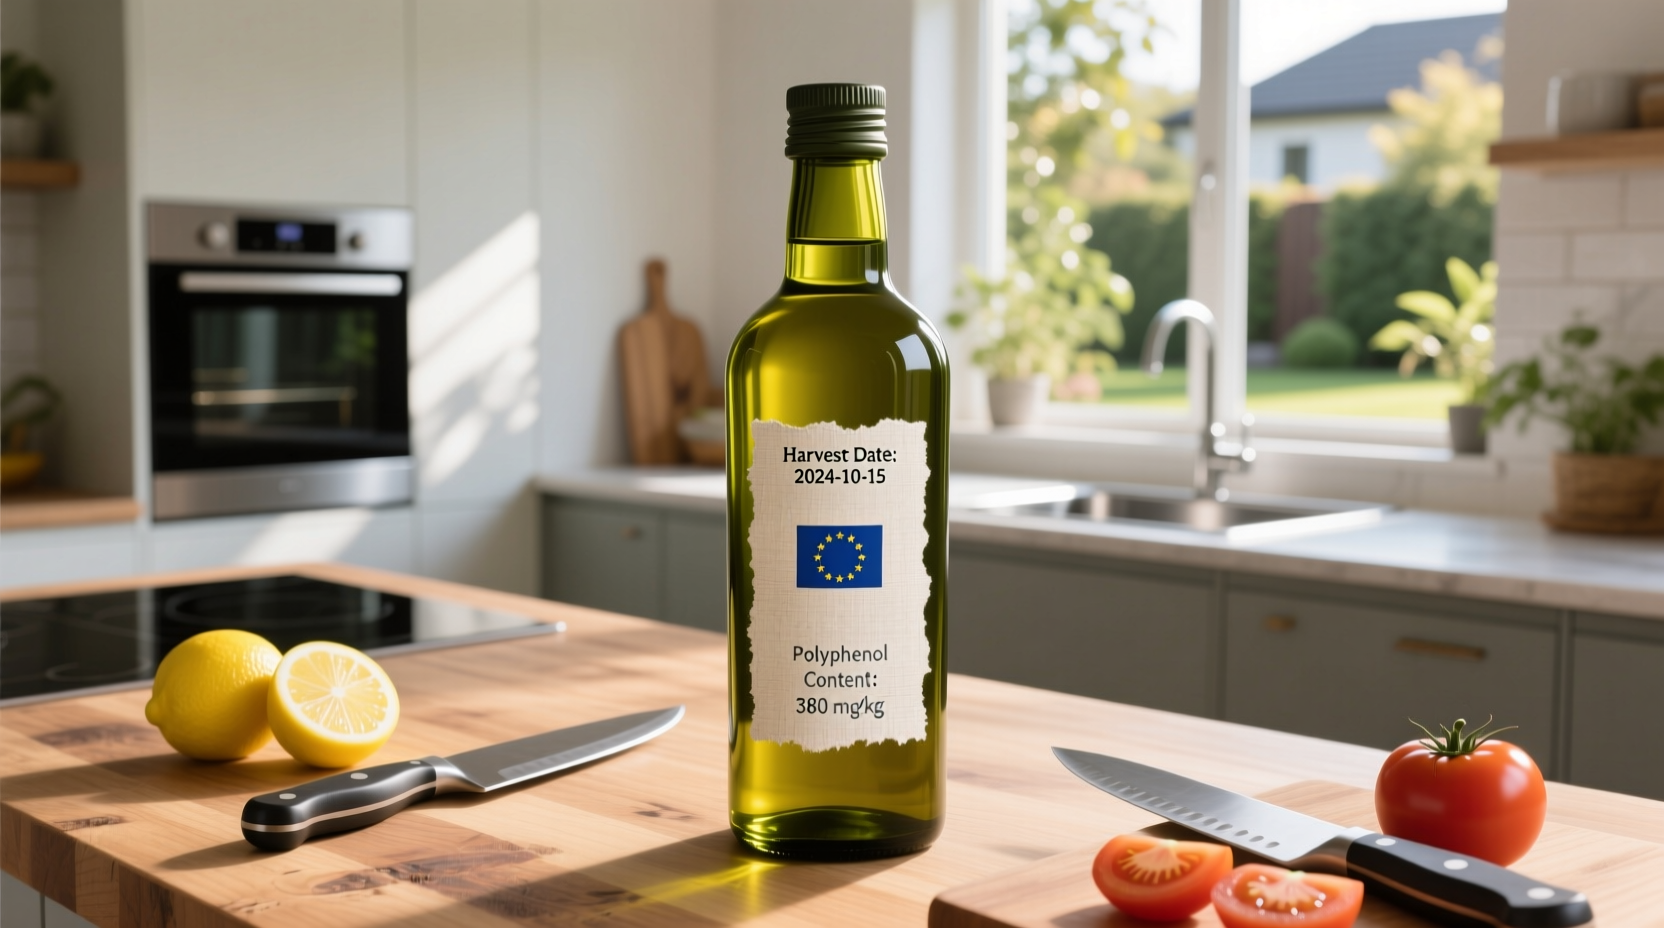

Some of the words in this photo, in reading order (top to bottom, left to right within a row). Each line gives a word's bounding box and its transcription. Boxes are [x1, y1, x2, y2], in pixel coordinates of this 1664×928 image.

[782, 446, 850, 463] Harvest
[853, 446, 897, 463] Date:
[794, 467, 886, 485] 2024-10-15
[793, 643, 888, 668] Polyphenol
[803, 670, 877, 689] Content:
[795, 697, 828, 715] 380
[833, 695, 885, 720] mg/kg
